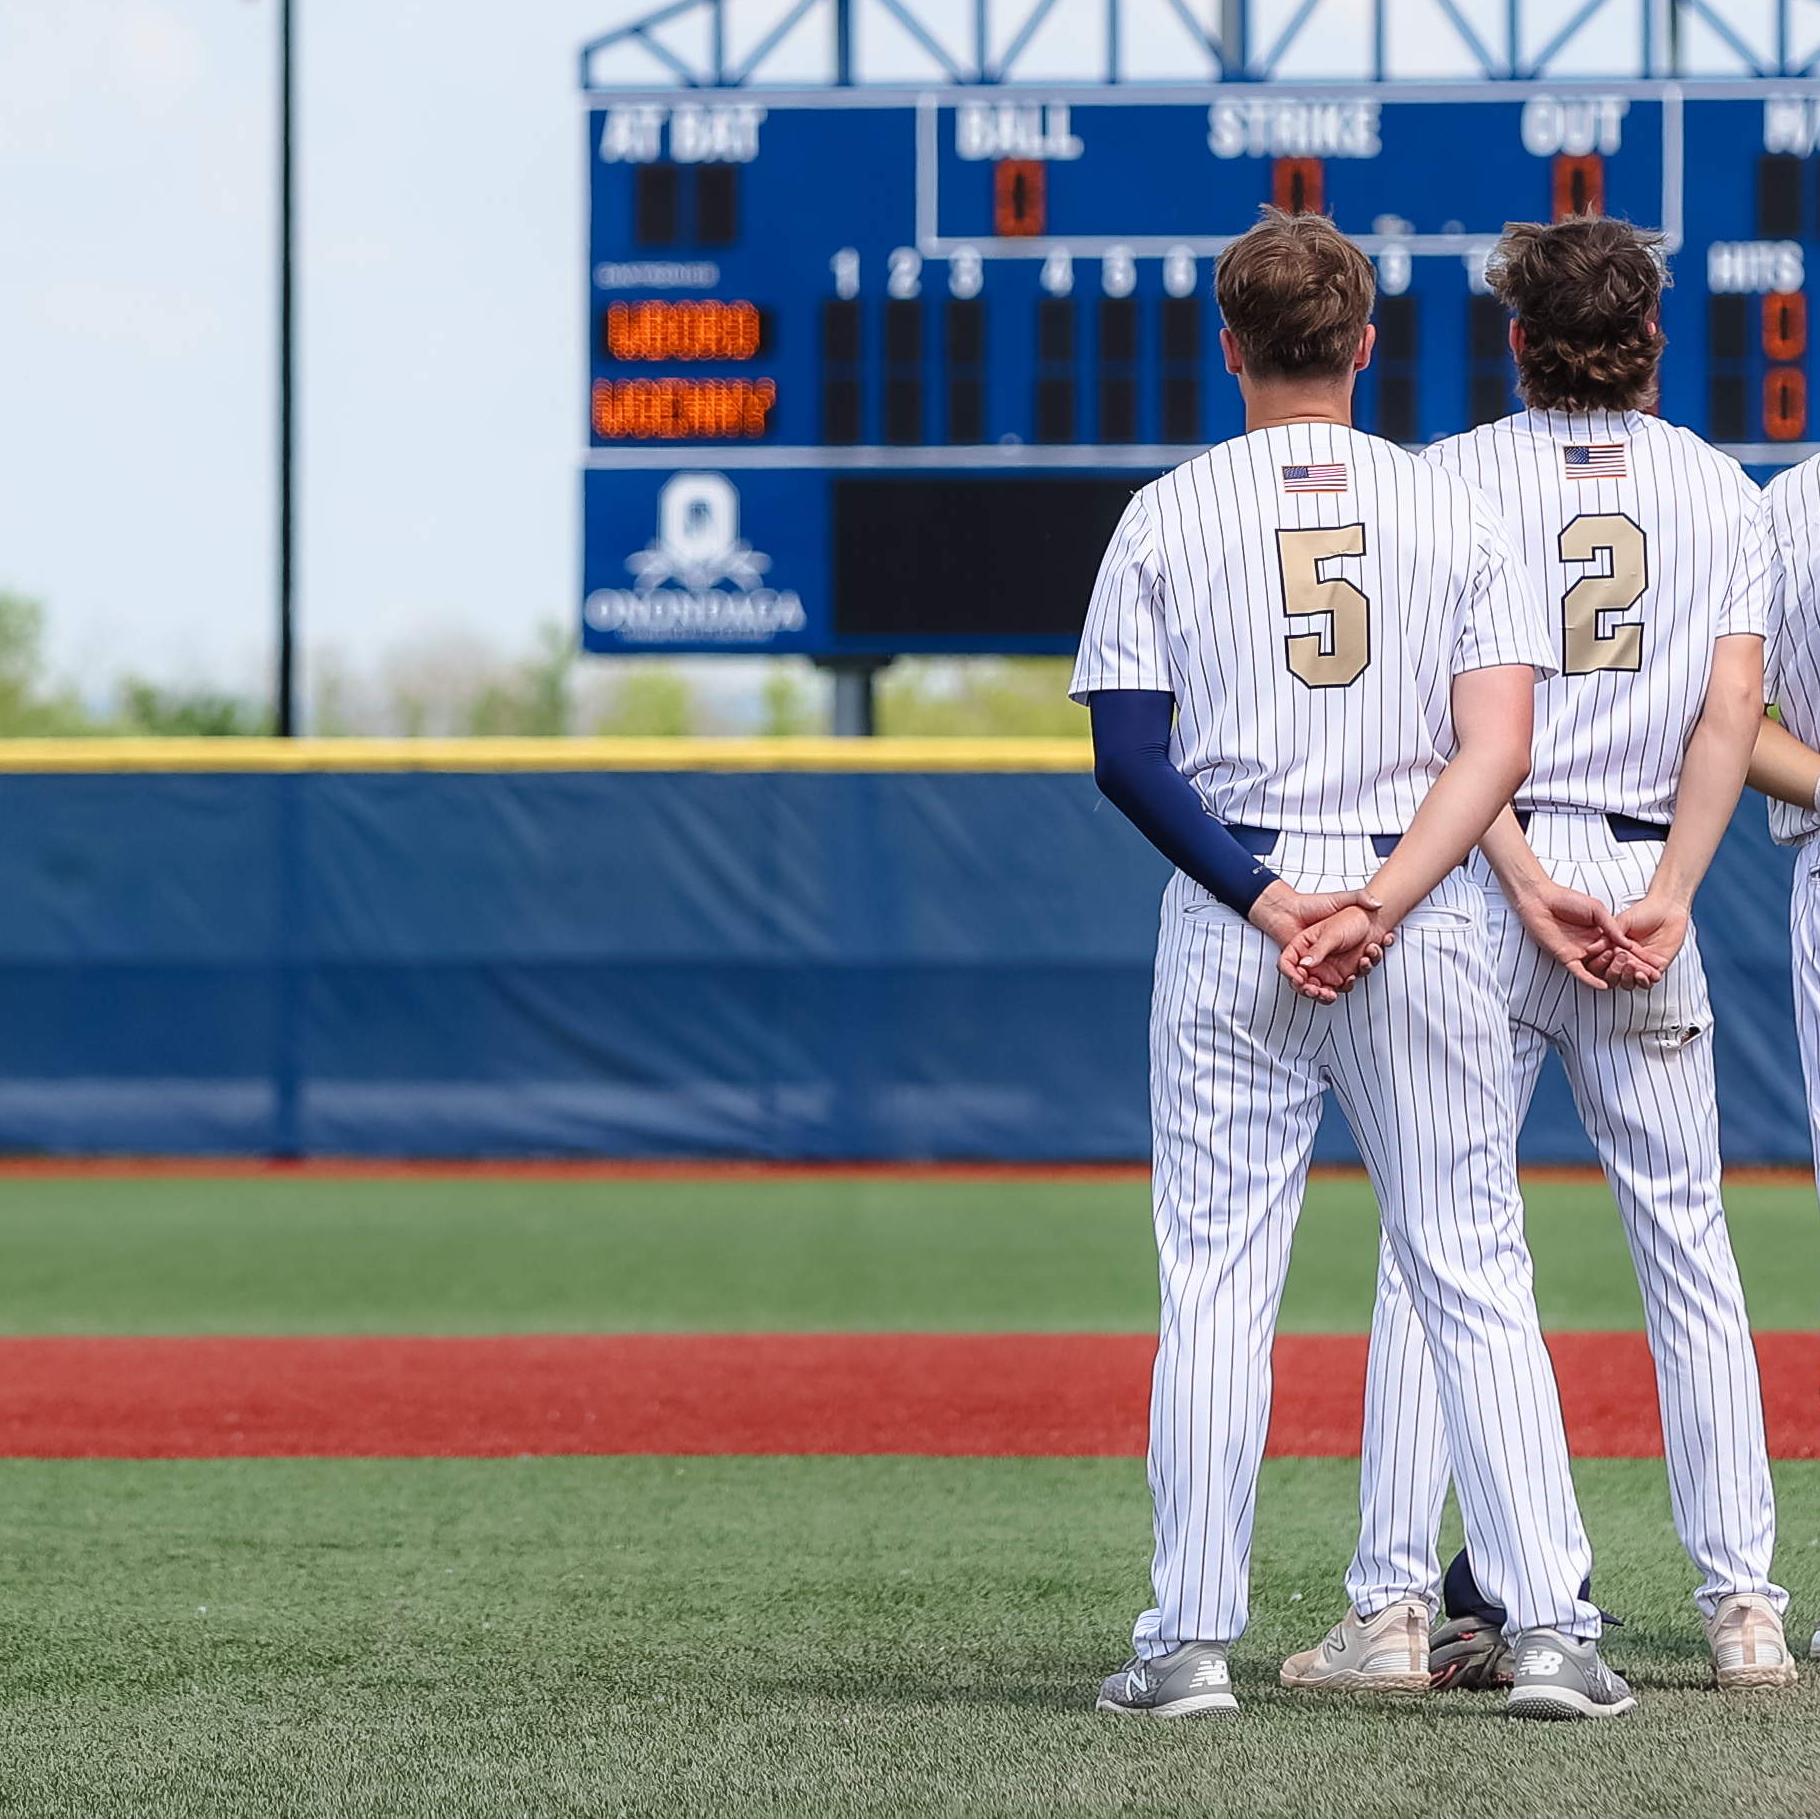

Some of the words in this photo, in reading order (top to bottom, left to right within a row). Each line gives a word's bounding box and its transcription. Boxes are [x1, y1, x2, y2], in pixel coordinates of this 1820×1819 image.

[600, 102, 664, 163] AT
[669, 102, 767, 163] BAT
[955, 100, 1084, 161] BALL
[1207, 96, 1382, 159] STRIKE
[1521, 94, 1630, 157] OUT
[829, 246, 860, 300] 1
[887, 246, 922, 300] 2
[948, 245, 983, 300] 3
[1039, 245, 1075, 298] 4
[1101, 244, 1137, 298] 5
[1162, 244, 1197, 298] 6
[1707, 240, 1805, 294] HITS
[1763, 367, 1806, 440] 0
[1275, 522, 1371, 690] 5
[1558, 512, 1649, 676] 2
